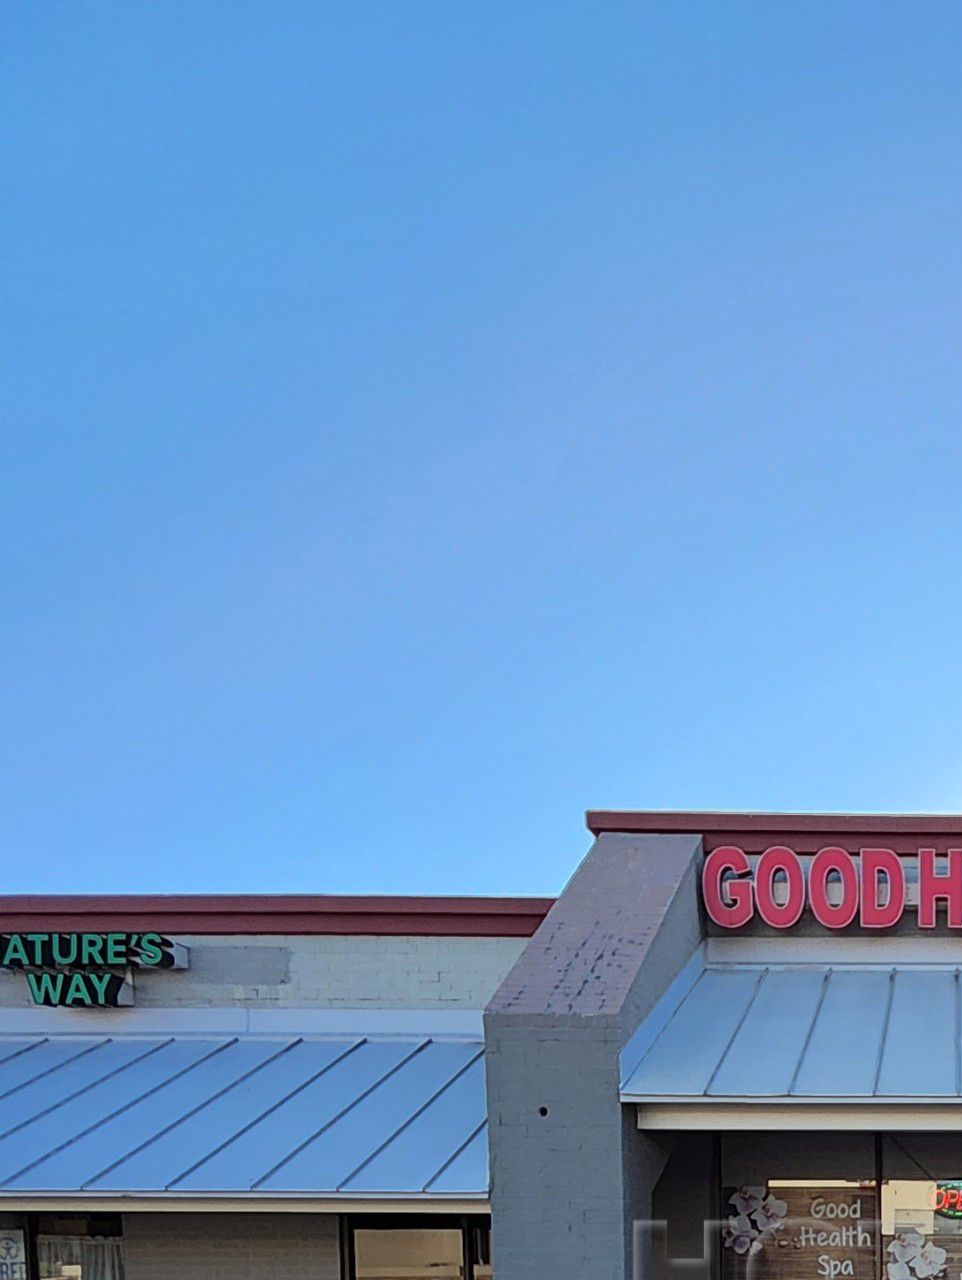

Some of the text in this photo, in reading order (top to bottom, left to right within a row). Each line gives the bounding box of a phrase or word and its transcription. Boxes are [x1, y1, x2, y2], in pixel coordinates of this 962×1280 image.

[702, 846, 905, 929] GOOD
[27, 973, 111, 1005] WAY
[810, 1199, 861, 1219] Good
[799, 1226, 871, 1248] Health
[817, 1255, 854, 1279] Spa
